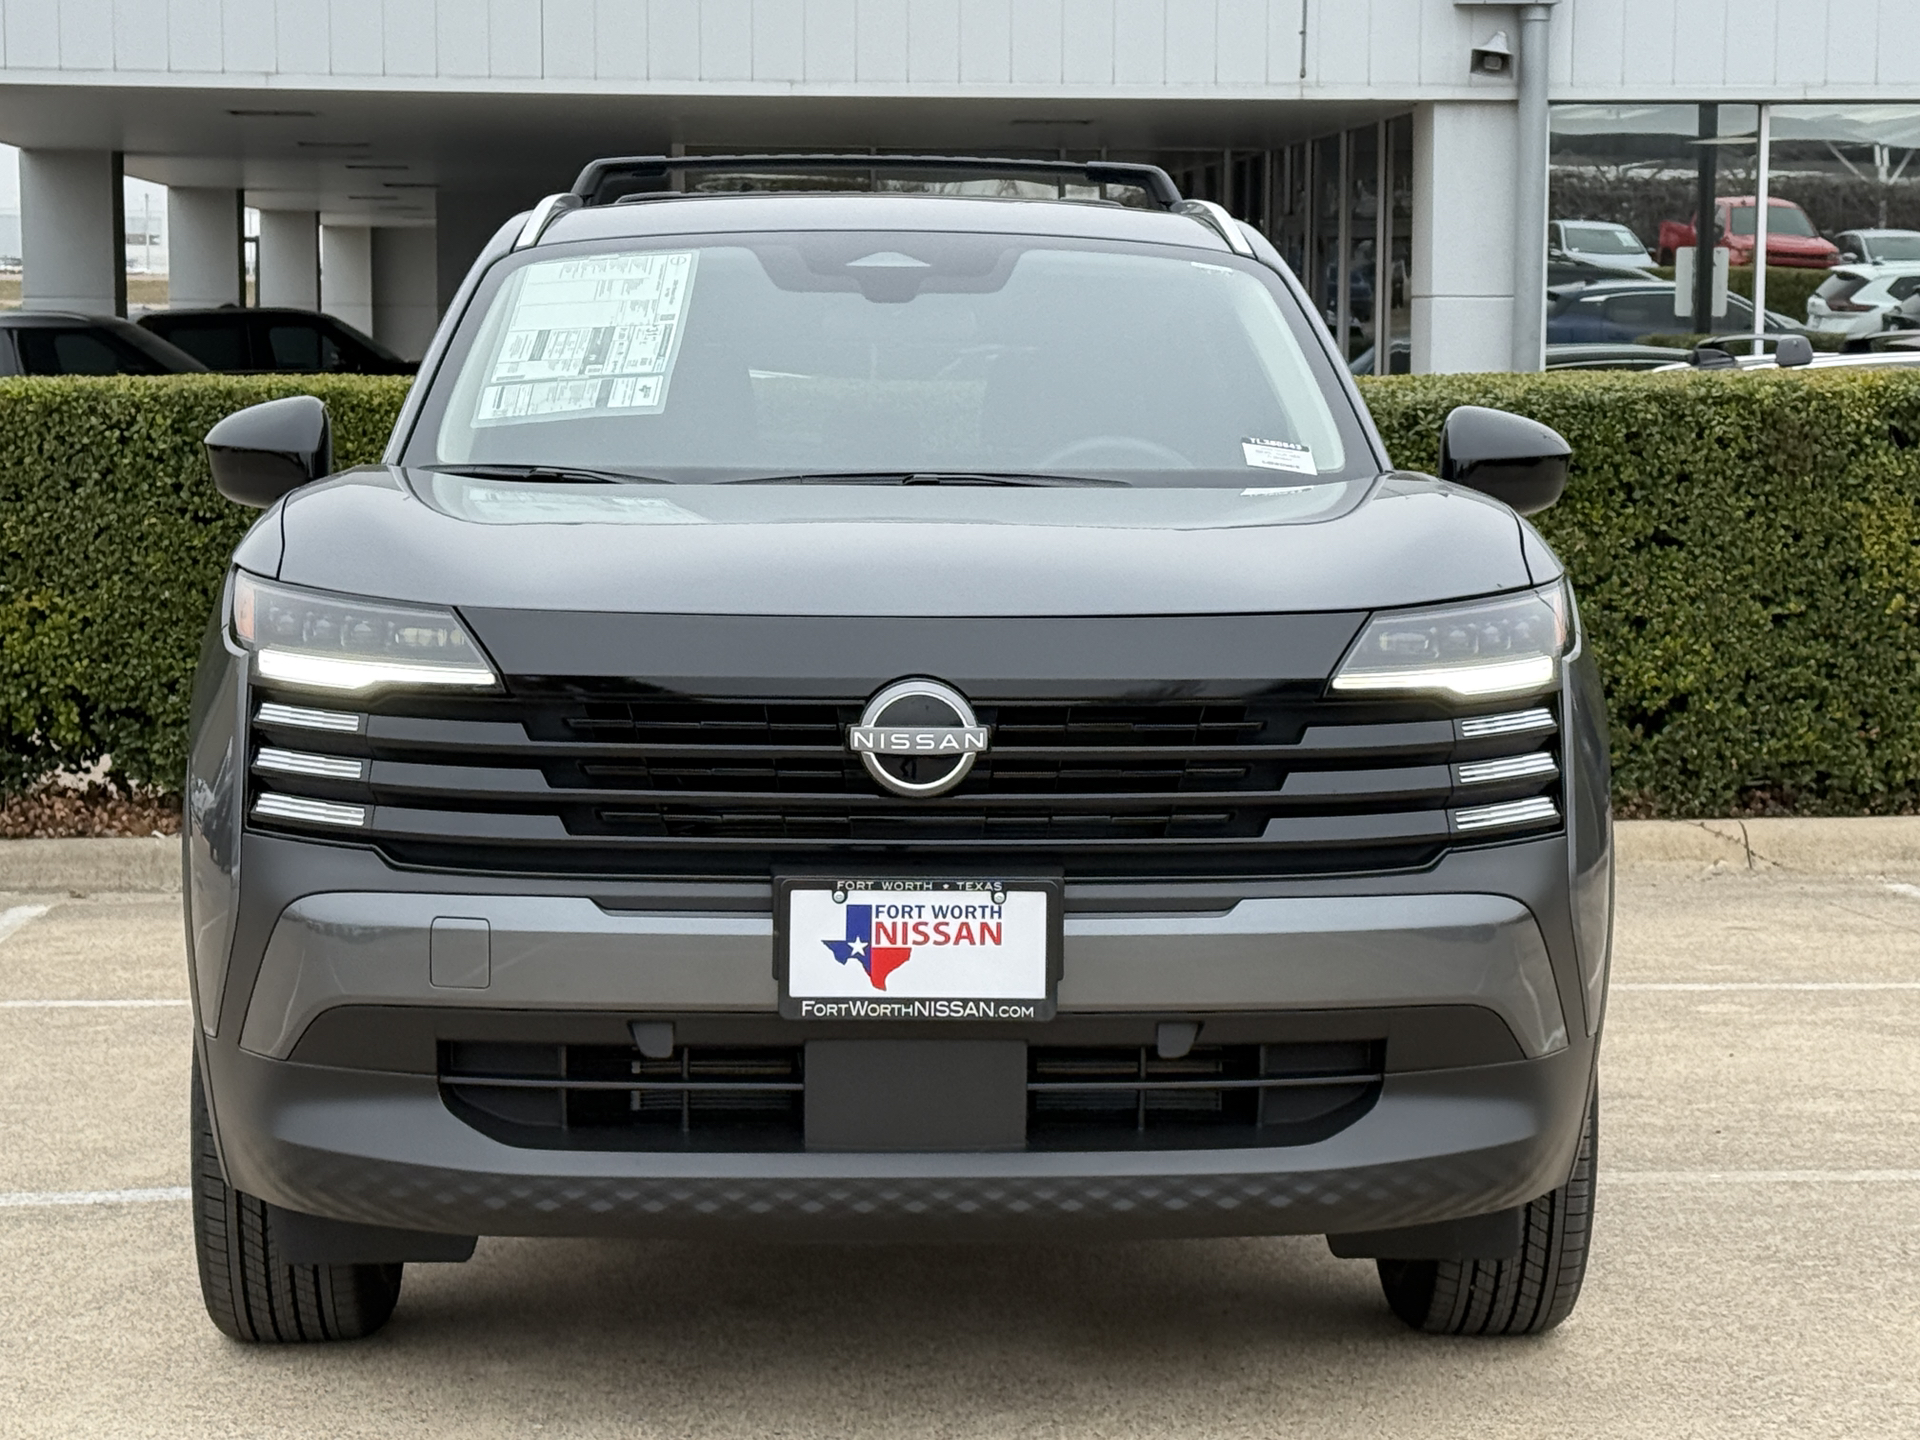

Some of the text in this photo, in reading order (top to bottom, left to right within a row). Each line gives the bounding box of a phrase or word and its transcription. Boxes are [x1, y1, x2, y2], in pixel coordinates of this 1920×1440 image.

[853, 731, 984, 750] NISSAN
[837, 880, 1003, 892] FORT WORTH TEXAS
[874, 904, 1003, 920] FORT WORTH
[874, 921, 1003, 946] NISSAN
